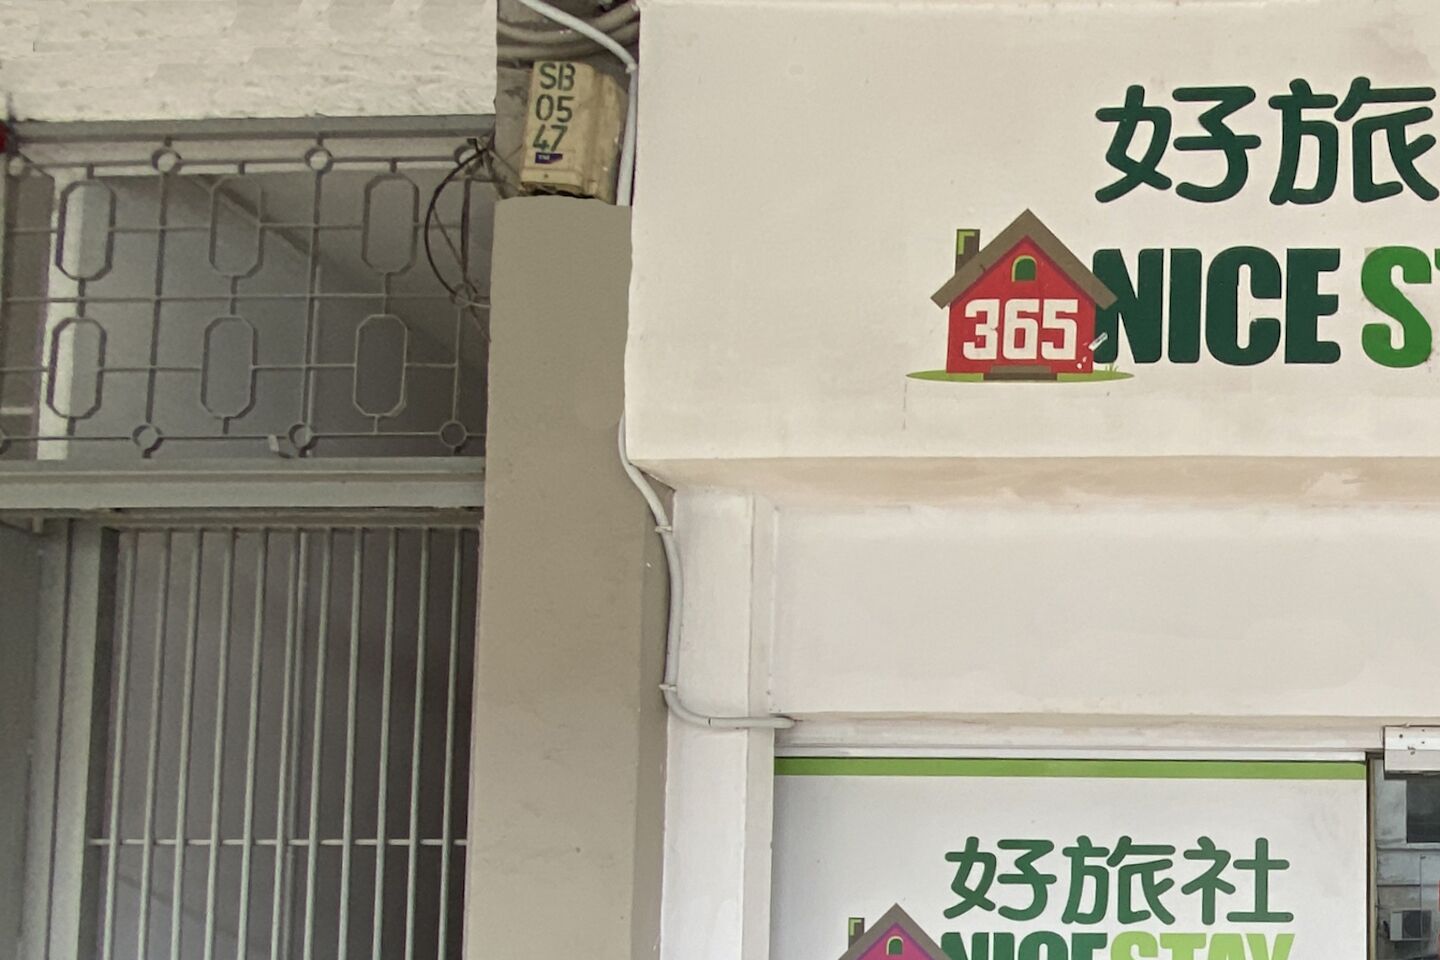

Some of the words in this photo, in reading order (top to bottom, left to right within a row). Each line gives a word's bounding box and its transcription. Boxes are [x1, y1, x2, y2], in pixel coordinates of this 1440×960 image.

[539, 63, 576, 91] SB
[535, 95, 574, 122] 05
[532, 124, 568, 152] 47
[1093, 246, 1341, 367] NICE
[963, 299, 1078, 361] 365
[943, 835, 1294, 925] 好旅社
